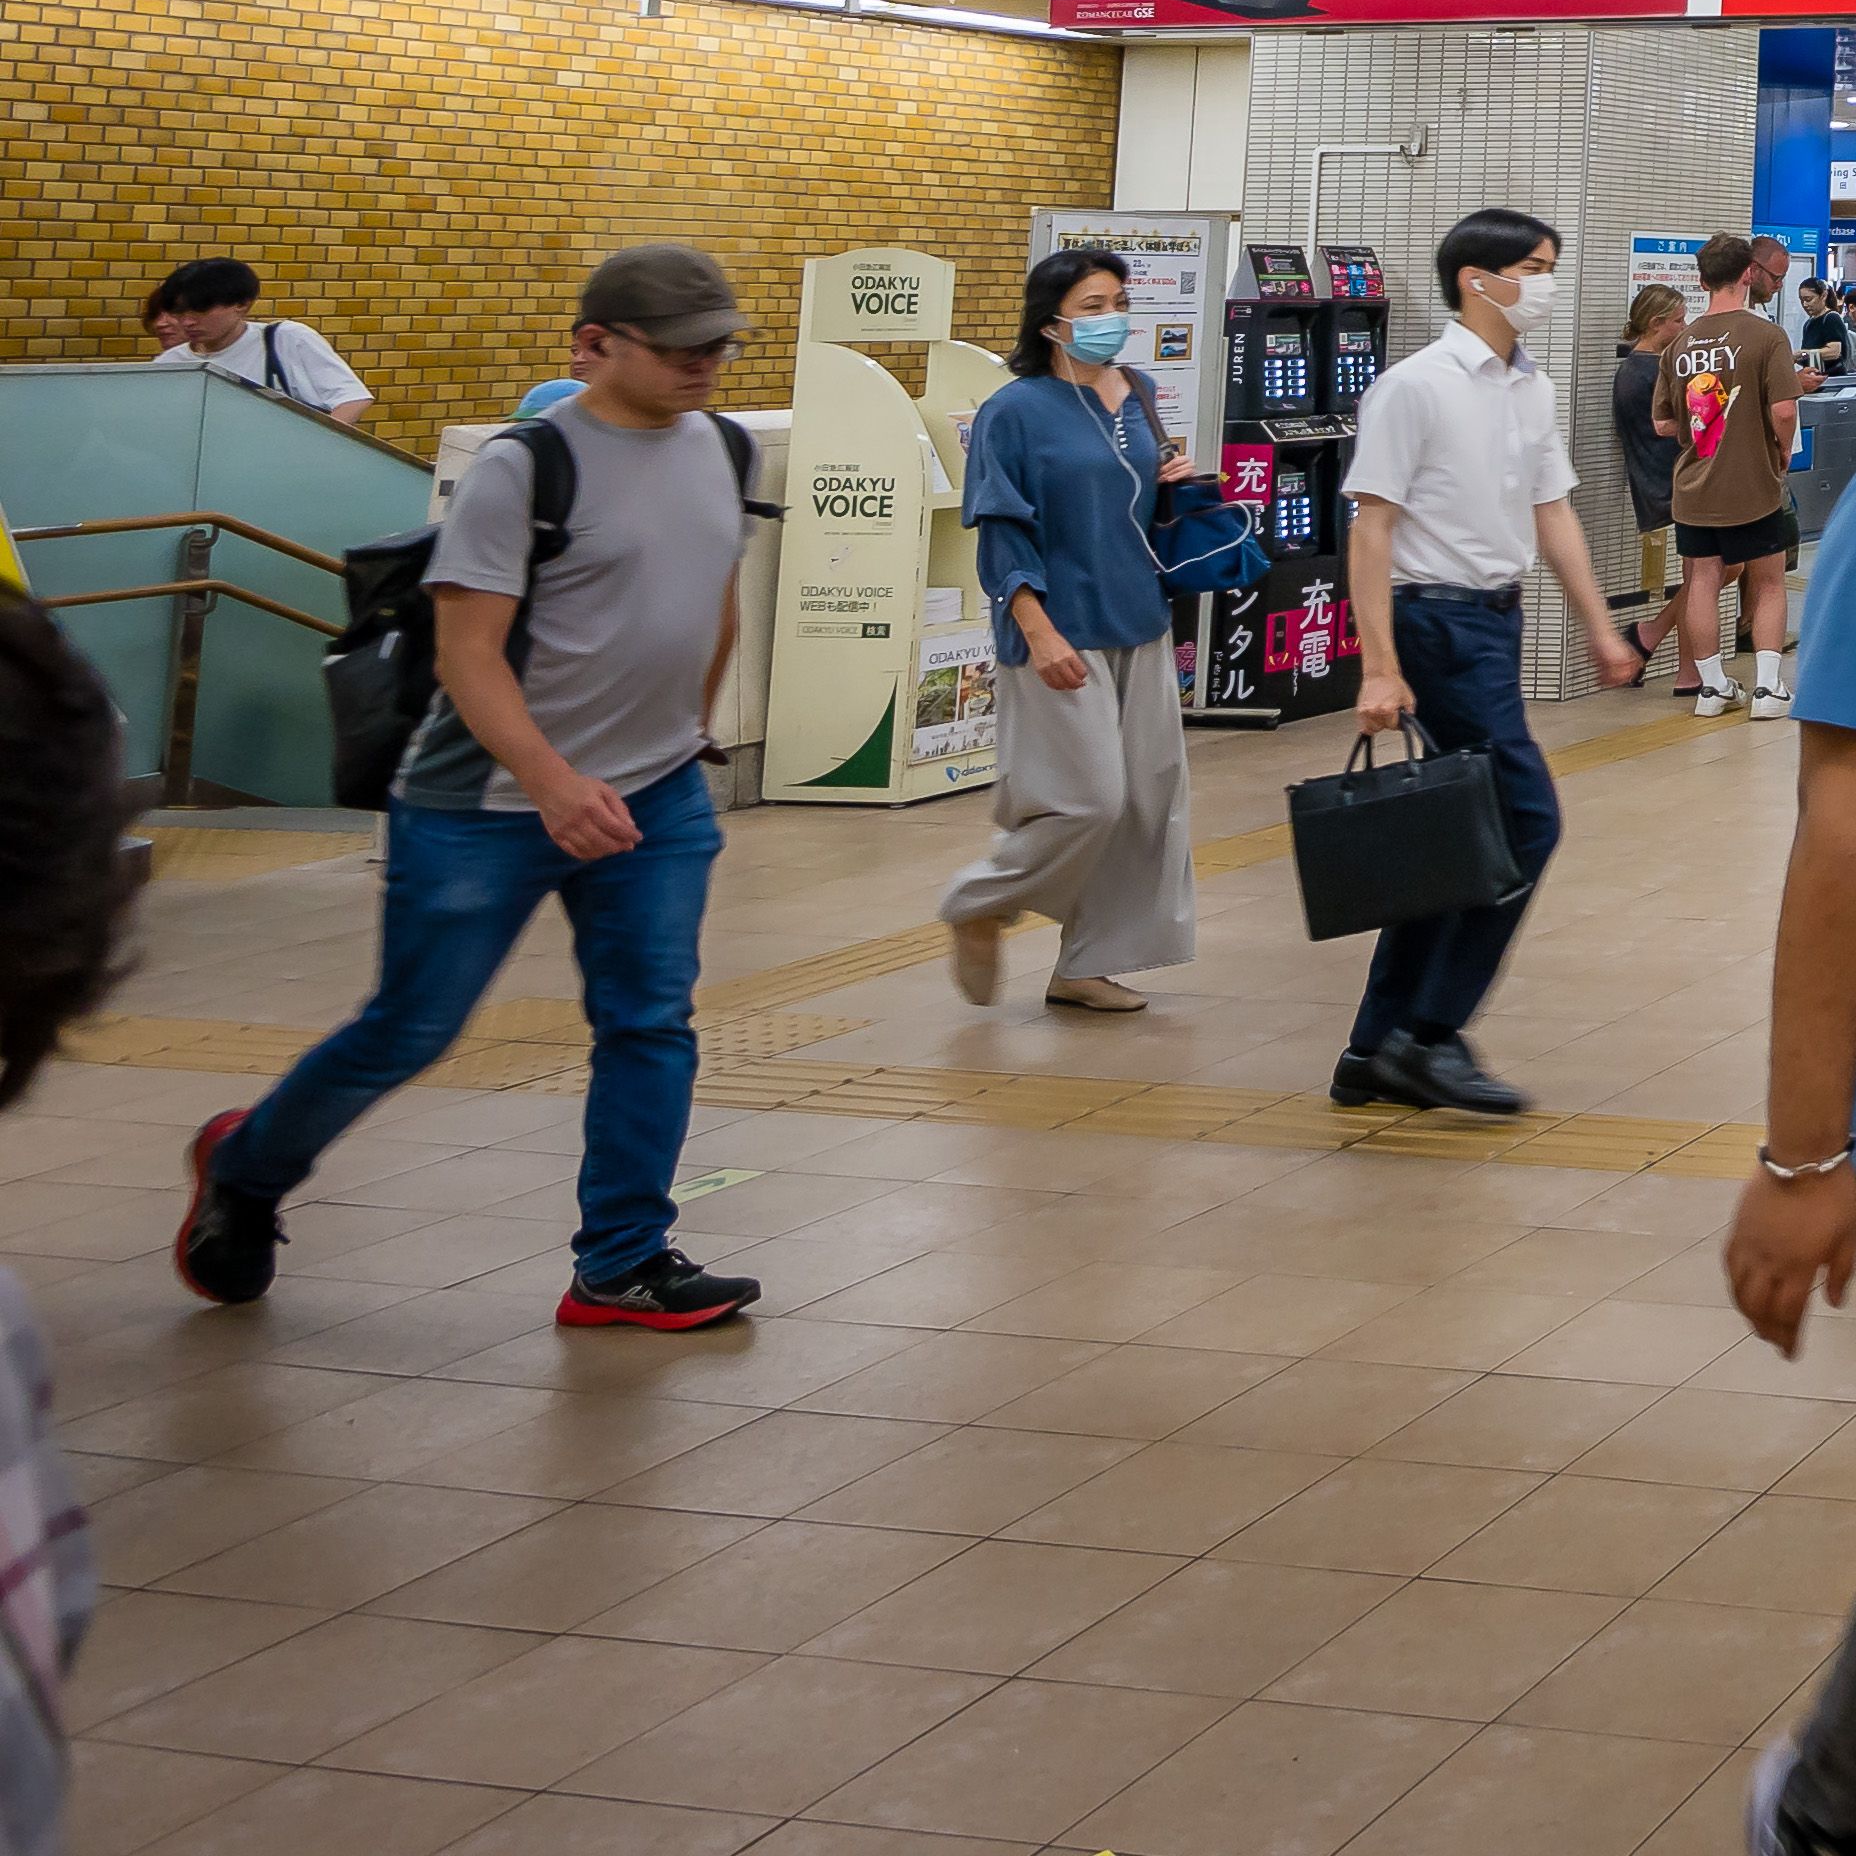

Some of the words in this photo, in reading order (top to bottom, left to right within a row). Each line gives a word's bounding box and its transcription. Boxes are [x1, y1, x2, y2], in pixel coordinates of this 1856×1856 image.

[851, 275, 920, 290] ODAKYU
[851, 292, 919, 315] VOICE
[1233, 333, 1246, 385] JUREN
[1676, 346, 1742, 377] OBEY
[813, 477, 895, 492] ODAKYU
[812, 494, 894, 518] VOICE
[801, 586, 852, 597] ODAKYU
[856, 586, 894, 598] VOICE
[1300, 579, 1334, 678] 充電
[929, 646, 980, 664] ODAKYU
